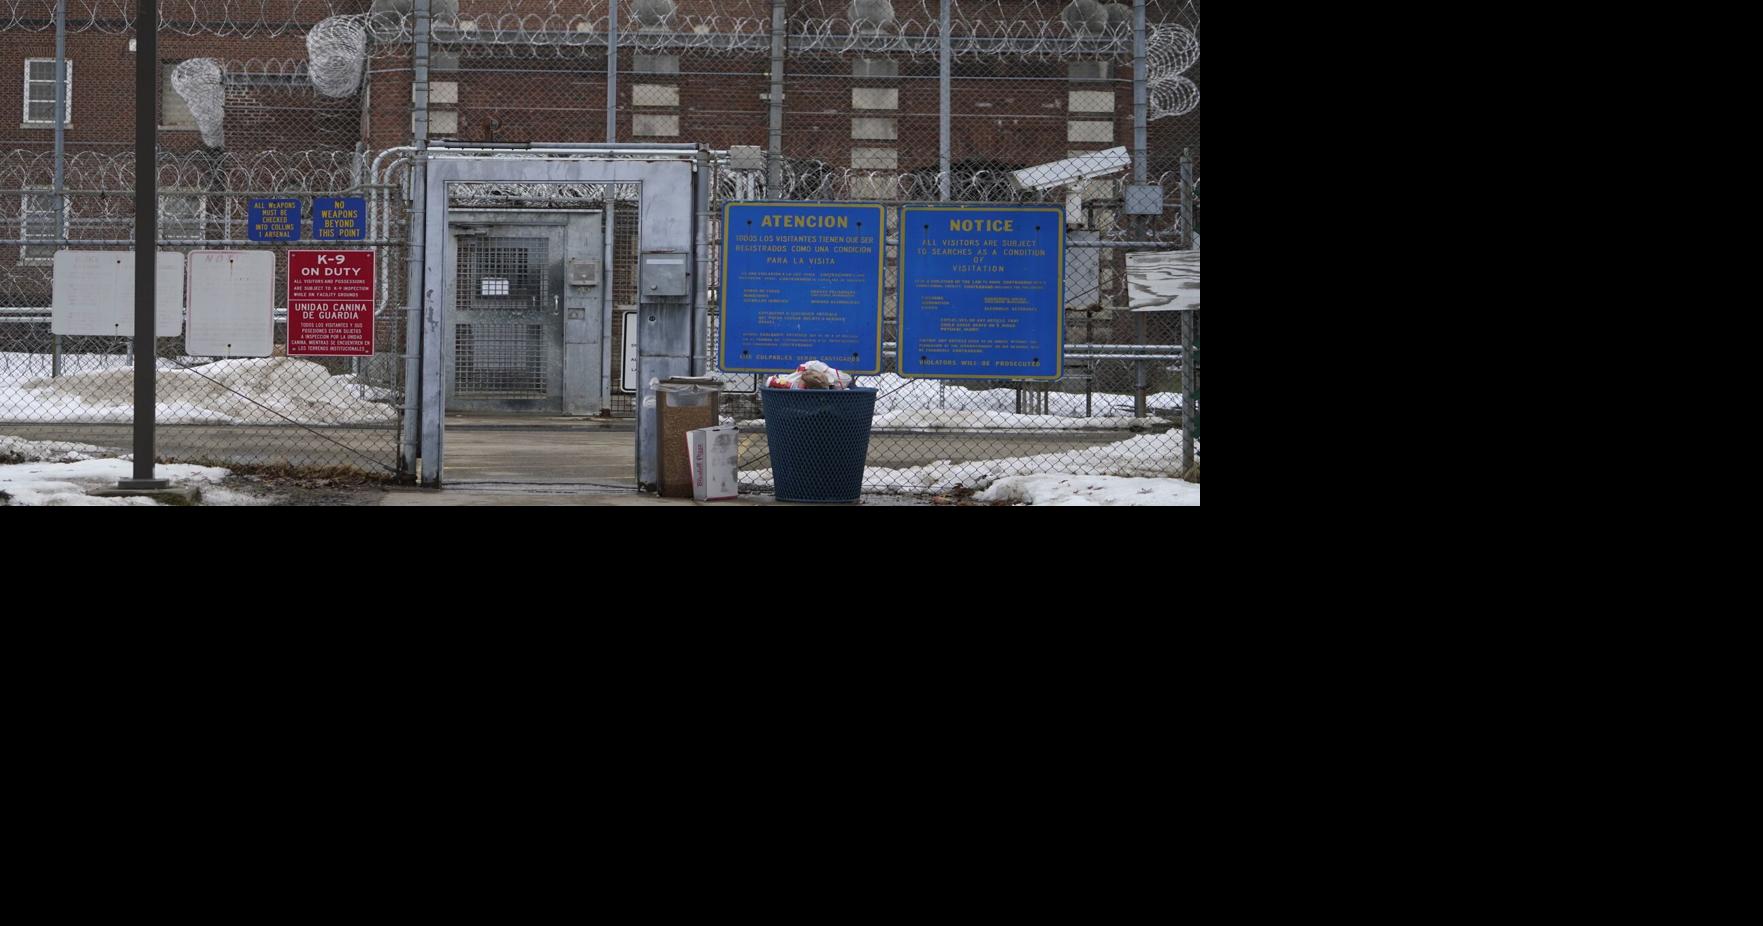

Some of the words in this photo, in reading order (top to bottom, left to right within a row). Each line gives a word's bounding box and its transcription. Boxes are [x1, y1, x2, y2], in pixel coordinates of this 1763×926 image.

[334, 201, 344, 209] NO
[322, 210, 358, 218] WEAPONS
[325, 220, 354, 228] BEYOND
[761, 215, 848, 228] ATENCION
[950, 220, 1014, 232] NOTICE
[320, 229, 334, 237] THIS
[340, 229, 360, 237] POINT
[736, 235, 758, 243] TODOS
[760, 235, 774, 243] LOS
[776, 235, 817, 243] VISITANTES
[819, 235, 844, 243] TIENEN
[845, 235, 858, 243] QUE
[860, 235, 874, 243] SER
[318, 255, 346, 265] K-9
[301, 268, 319, 276] ON
[325, 268, 360, 276] DUTY
